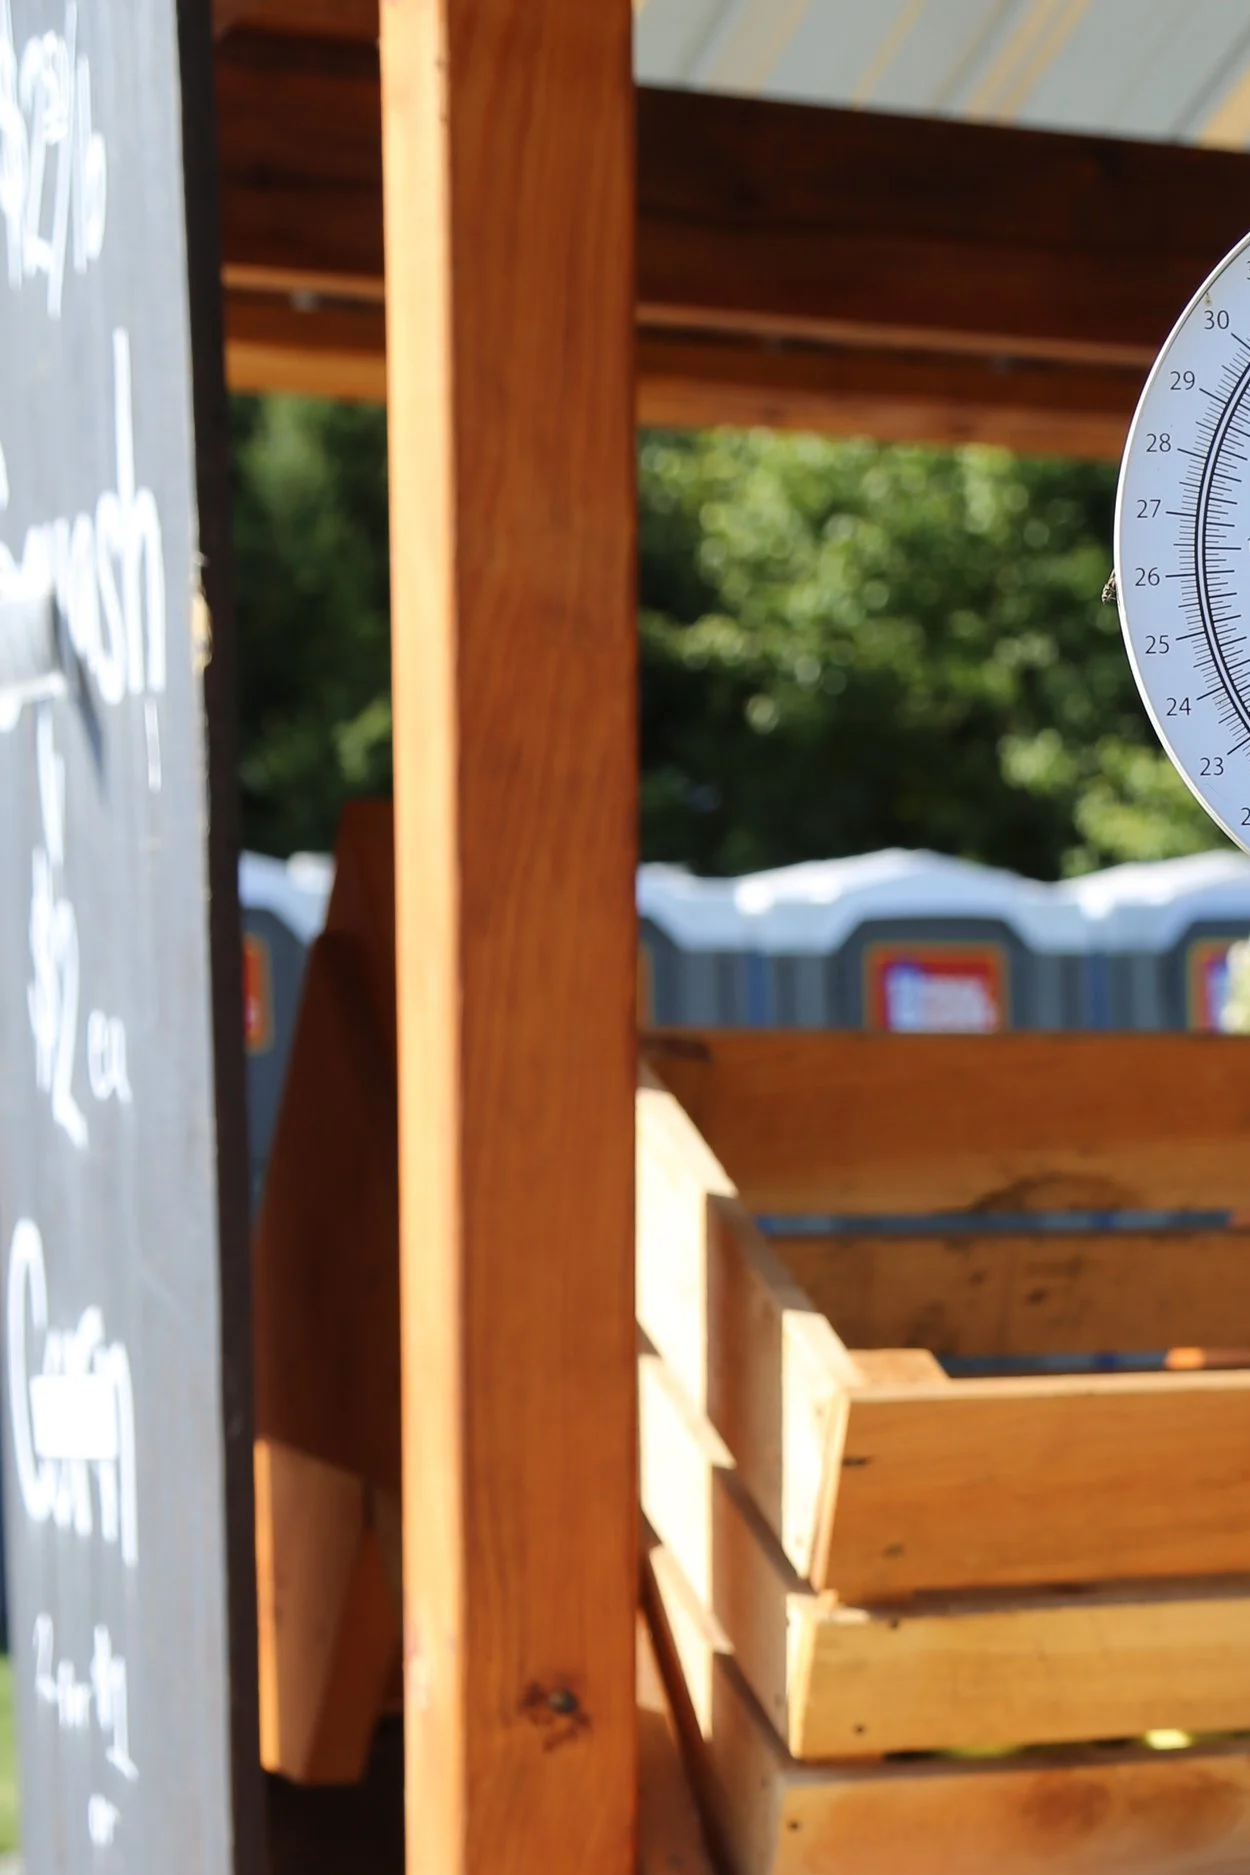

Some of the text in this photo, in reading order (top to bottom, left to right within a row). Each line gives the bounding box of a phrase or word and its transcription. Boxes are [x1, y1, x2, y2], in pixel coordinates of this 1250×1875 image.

[1203, 309, 1230, 330] 30
[1169, 370, 1196, 391] 29
[1145, 432, 1172, 453] 28
[1136, 498, 1162, 519] 27
[1134, 566, 1161, 587] 26
[1144, 634, 1170, 655] 25
[1165, 696, 1192, 717] 24
[1199, 756, 1225, 777] 23
